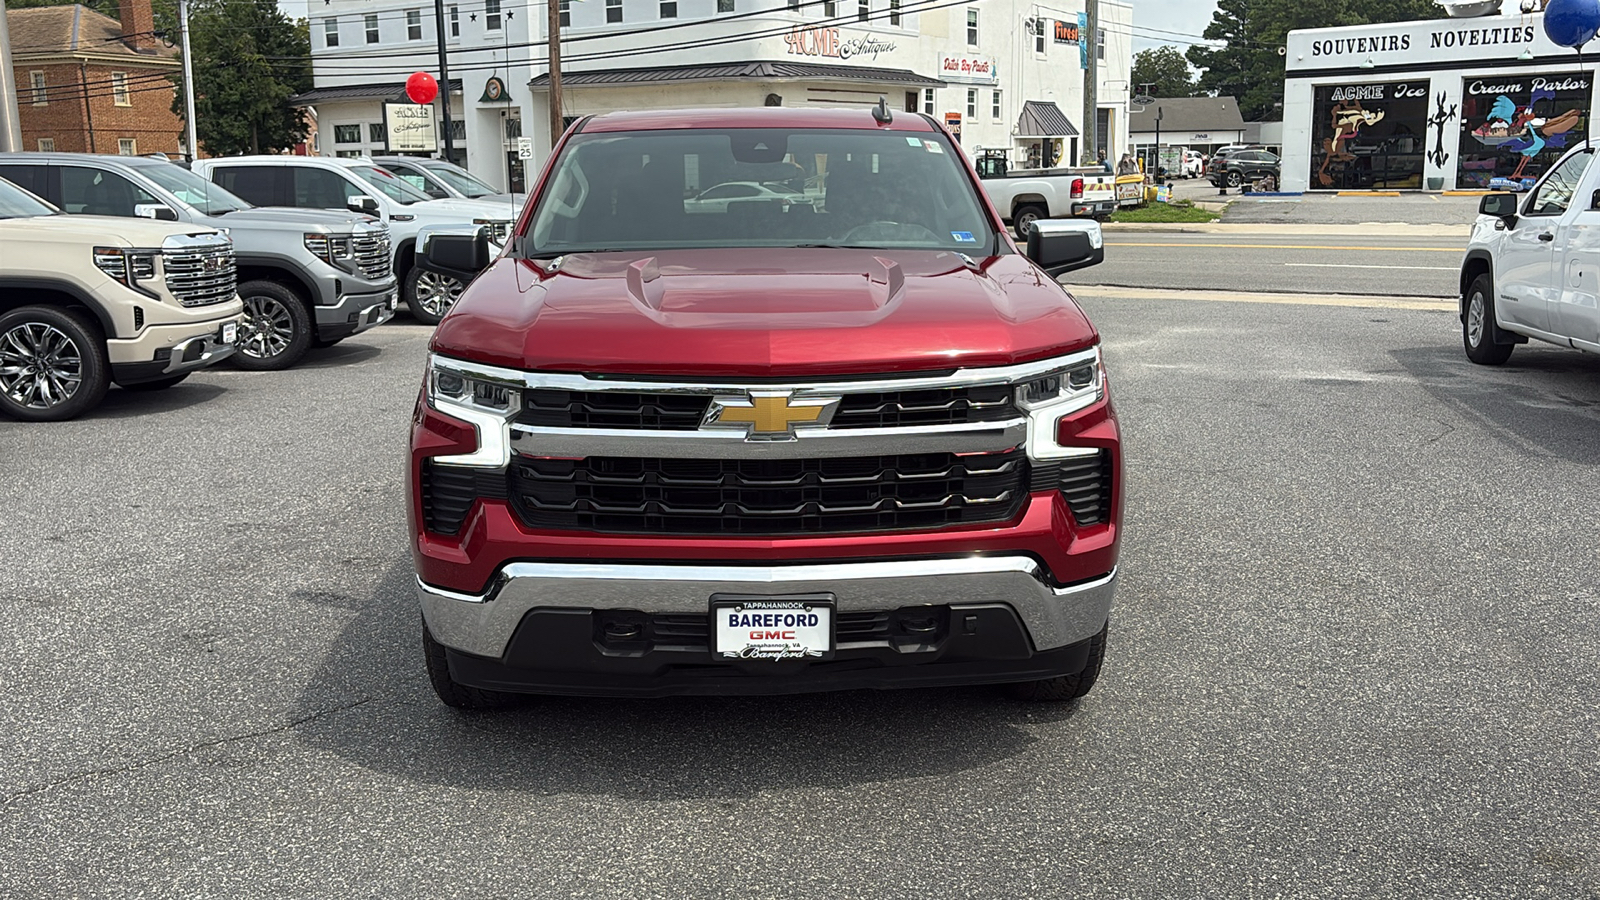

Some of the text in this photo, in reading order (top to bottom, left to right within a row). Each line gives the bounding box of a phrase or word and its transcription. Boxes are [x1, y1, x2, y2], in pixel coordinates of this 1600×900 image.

[784, 24, 897, 61] ACME Antiques
[1312, 25, 1535, 56] SOUVENIRS NOVELTIES
[943, 57, 989, 75] Dutch Boy Paints
[1331, 77, 1589, 101] ACME Ice Cream Parlor
[520, 148, 531, 157] 25
[729, 614, 819, 627] BAREFORD
[749, 631, 796, 640] GMC
[740, 646, 808, 662] Bareford
